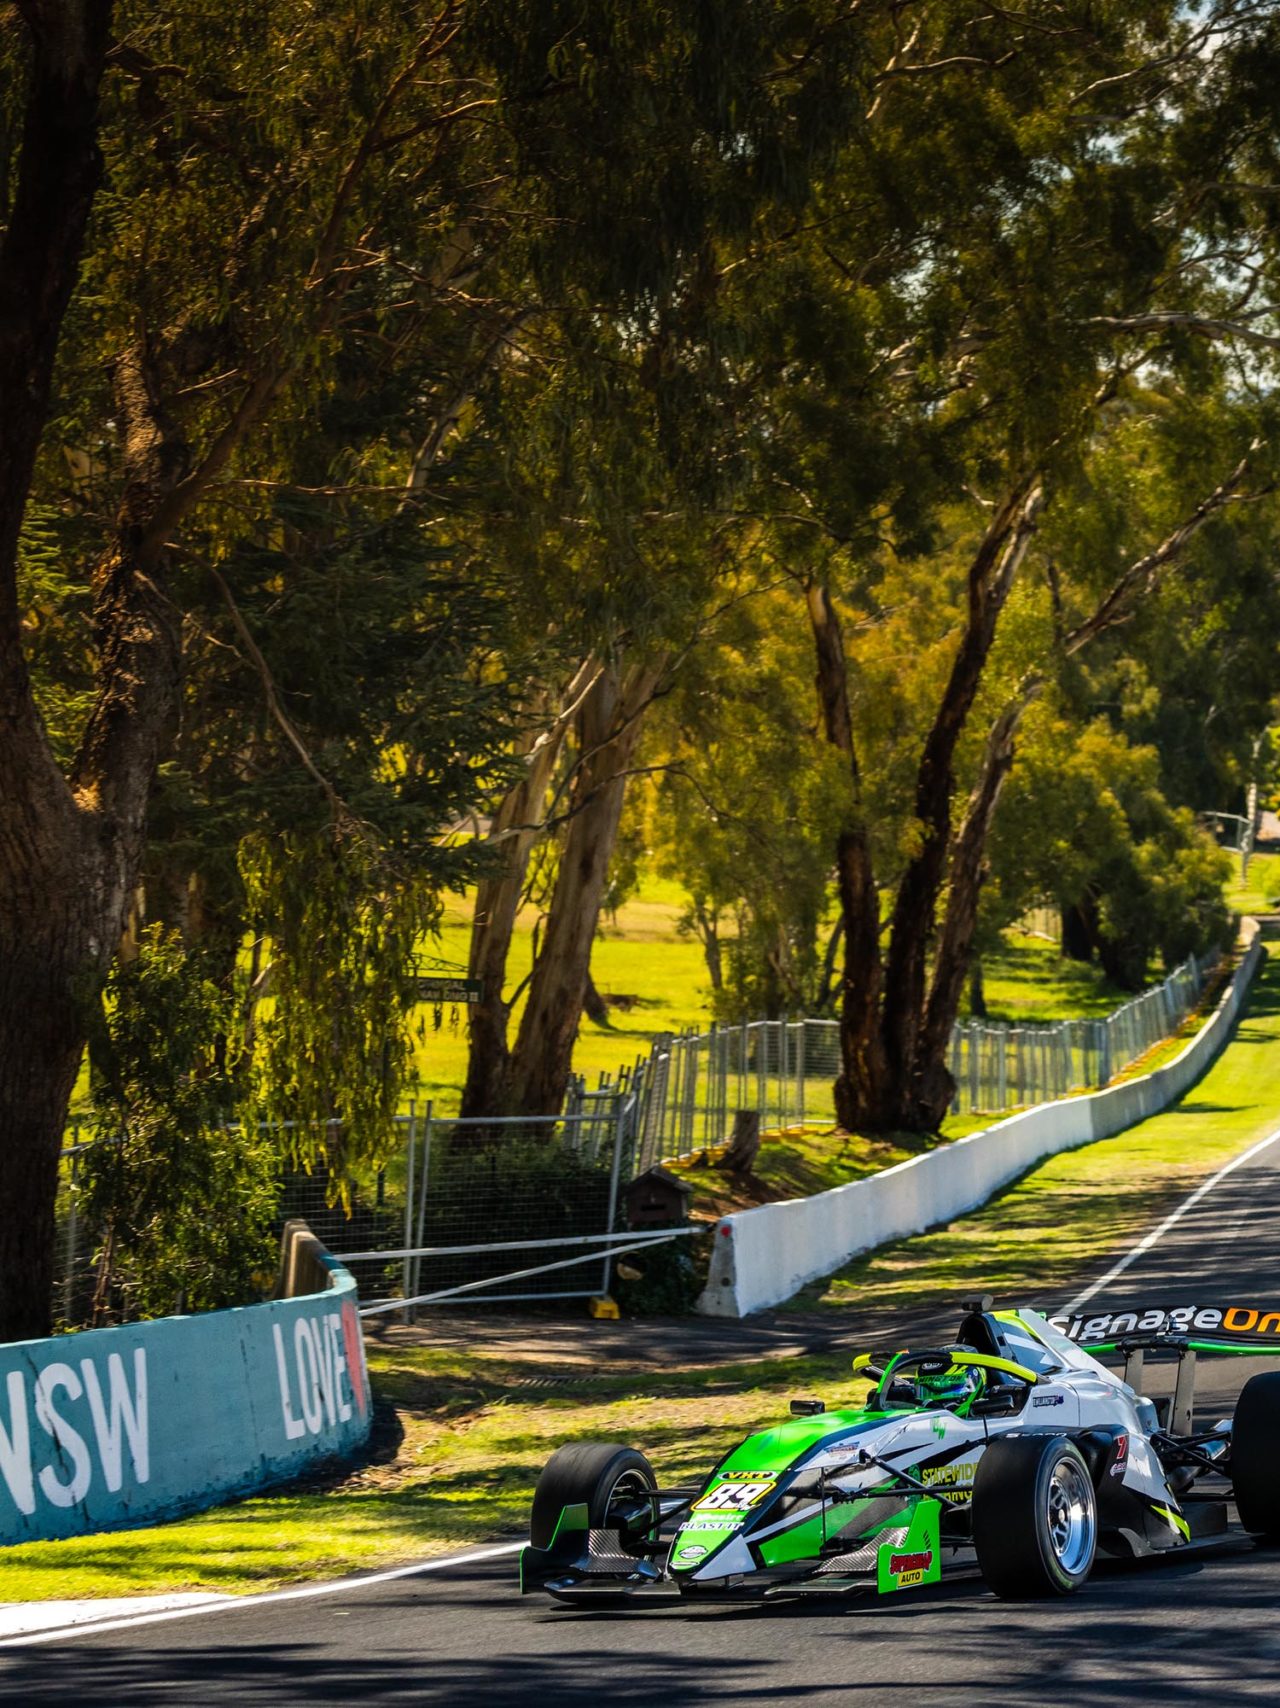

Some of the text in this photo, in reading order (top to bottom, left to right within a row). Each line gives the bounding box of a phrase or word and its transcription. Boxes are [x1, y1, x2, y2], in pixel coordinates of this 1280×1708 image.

[273, 1314, 352, 1440] LOVE
[695, 1483, 771, 1510] 89
[679, 1522, 744, 1531] BLAST IT
[900, 1571, 921, 1583] AUTO
